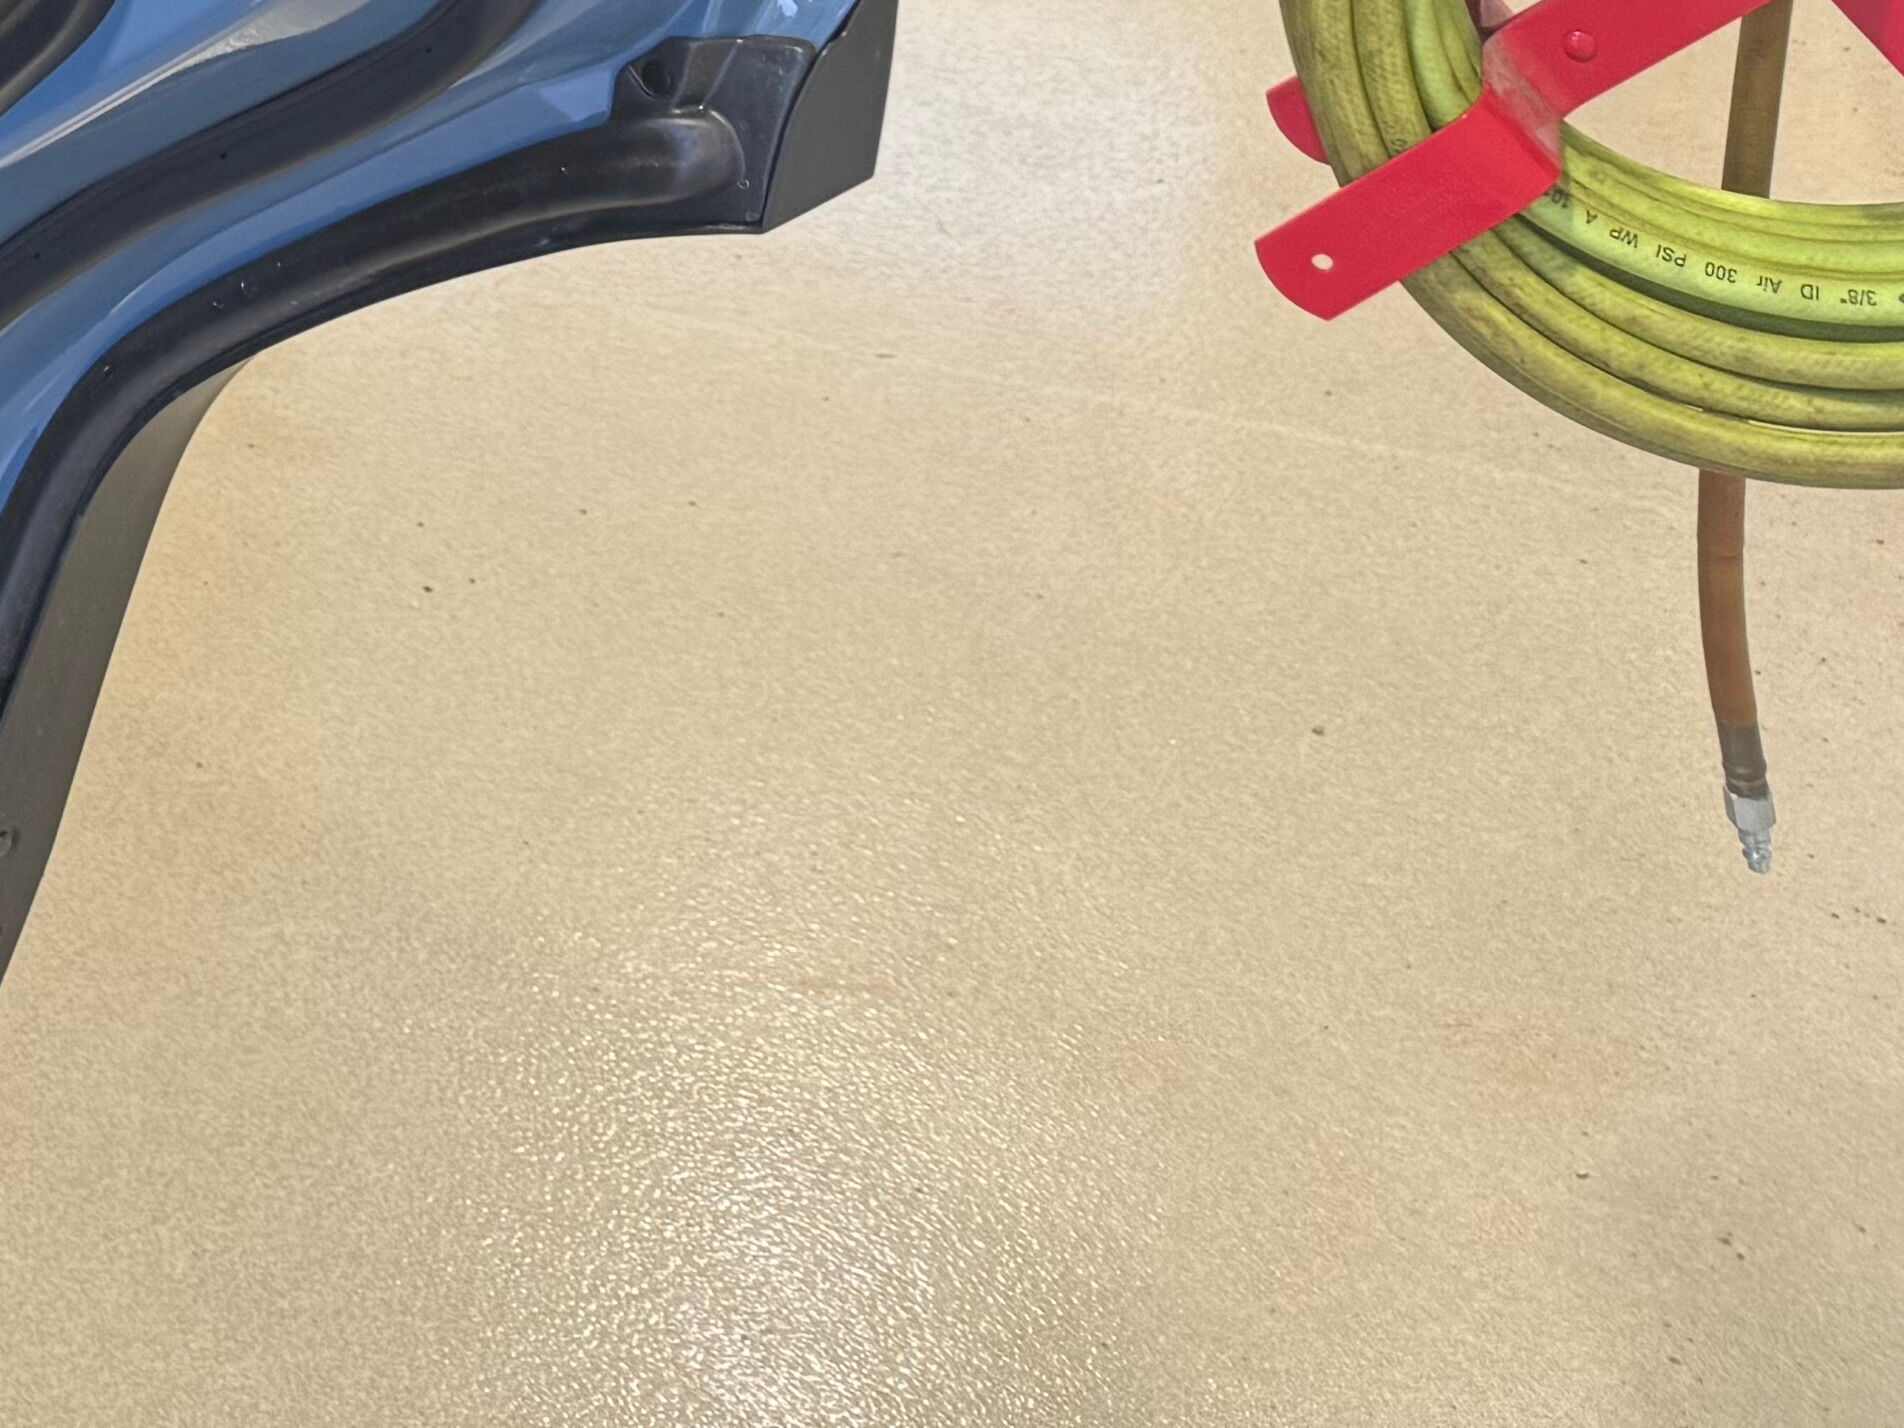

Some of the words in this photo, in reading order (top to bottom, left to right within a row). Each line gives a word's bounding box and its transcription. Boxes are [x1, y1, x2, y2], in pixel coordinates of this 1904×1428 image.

[1585, 210, 1599, 225] A
[1609, 226, 1639, 249] WP
[1656, 243, 1687, 268] PSI
[1704, 261, 1738, 284] 300
[1756, 275, 1782, 294] Air
[1800, 283, 1820, 301] ID
[1839, 288, 1878, 308] 3/8"
